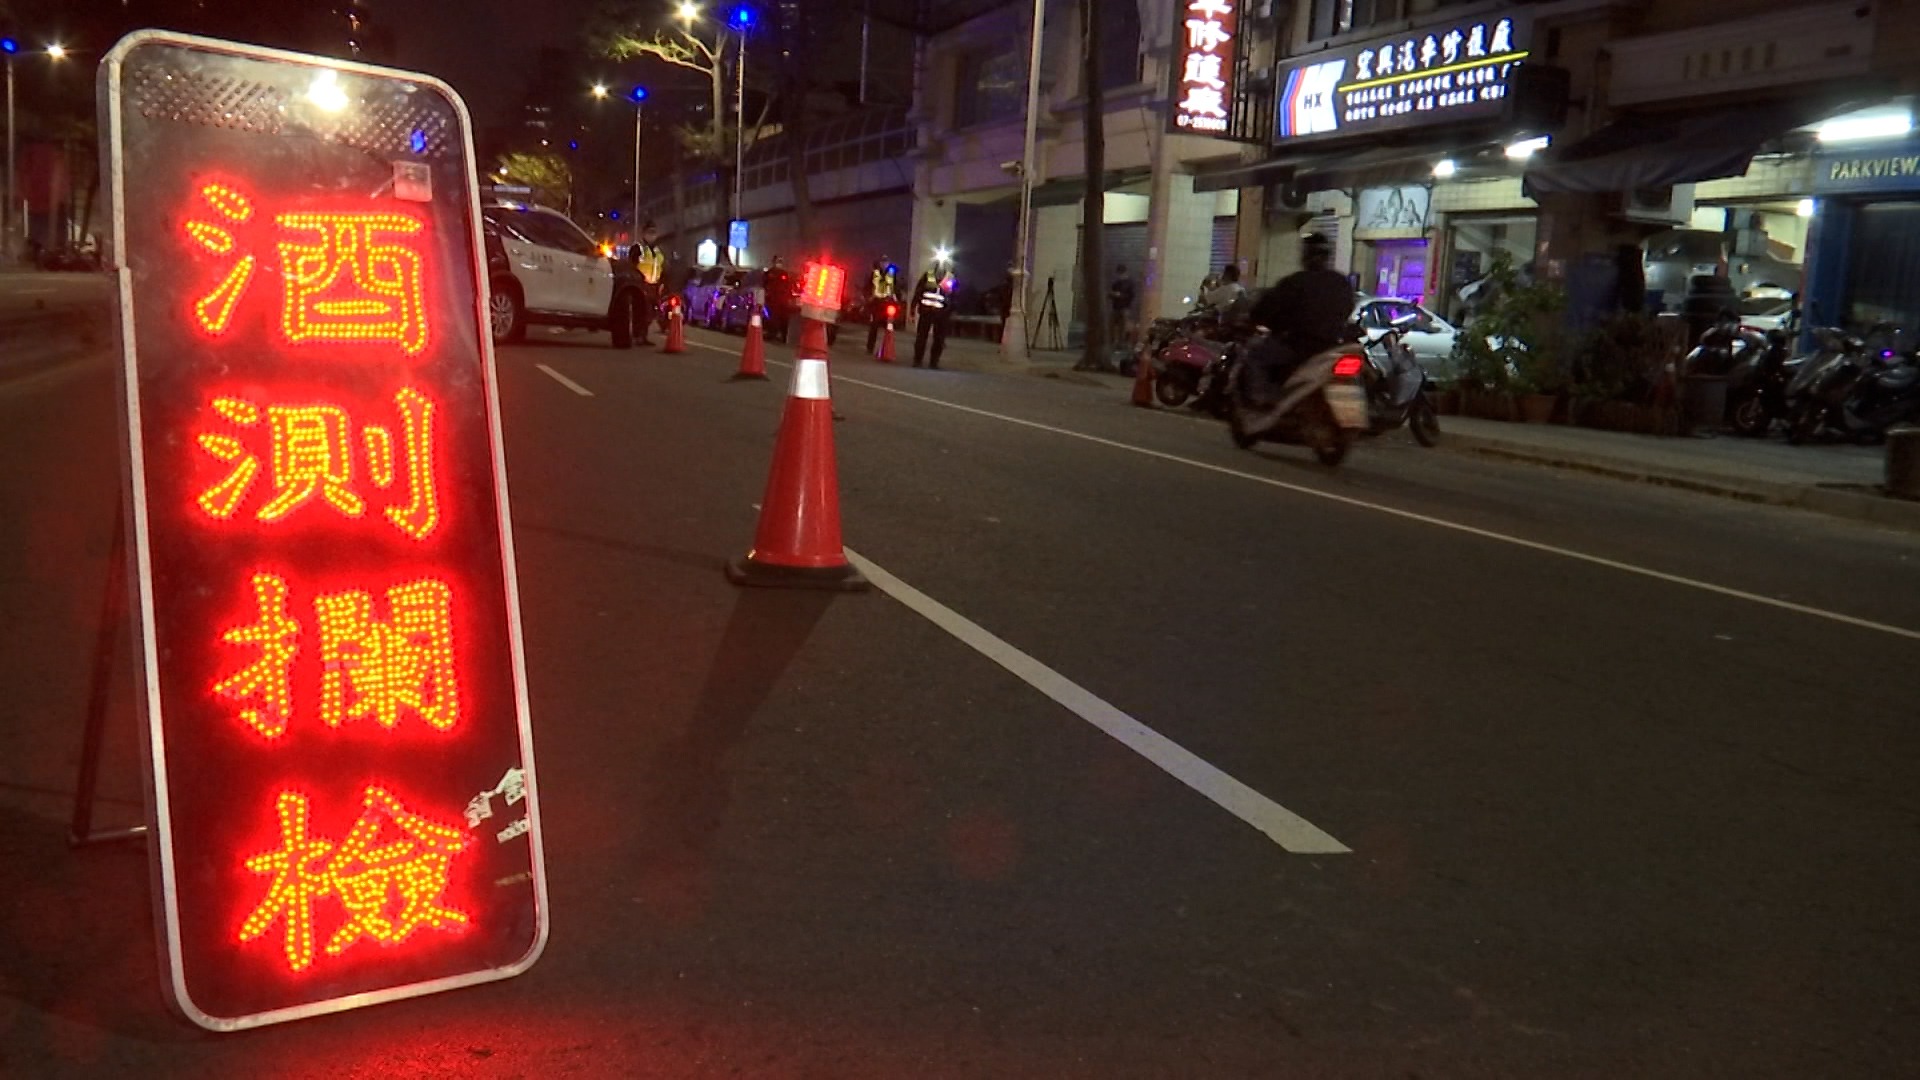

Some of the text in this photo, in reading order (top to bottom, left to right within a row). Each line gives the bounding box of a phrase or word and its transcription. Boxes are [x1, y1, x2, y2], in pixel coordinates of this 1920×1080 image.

[1303, 92, 1322, 110] HX
[1830, 155, 1919, 180] PARKVIEW
[184, 181, 472, 973] 酒測攔檢
